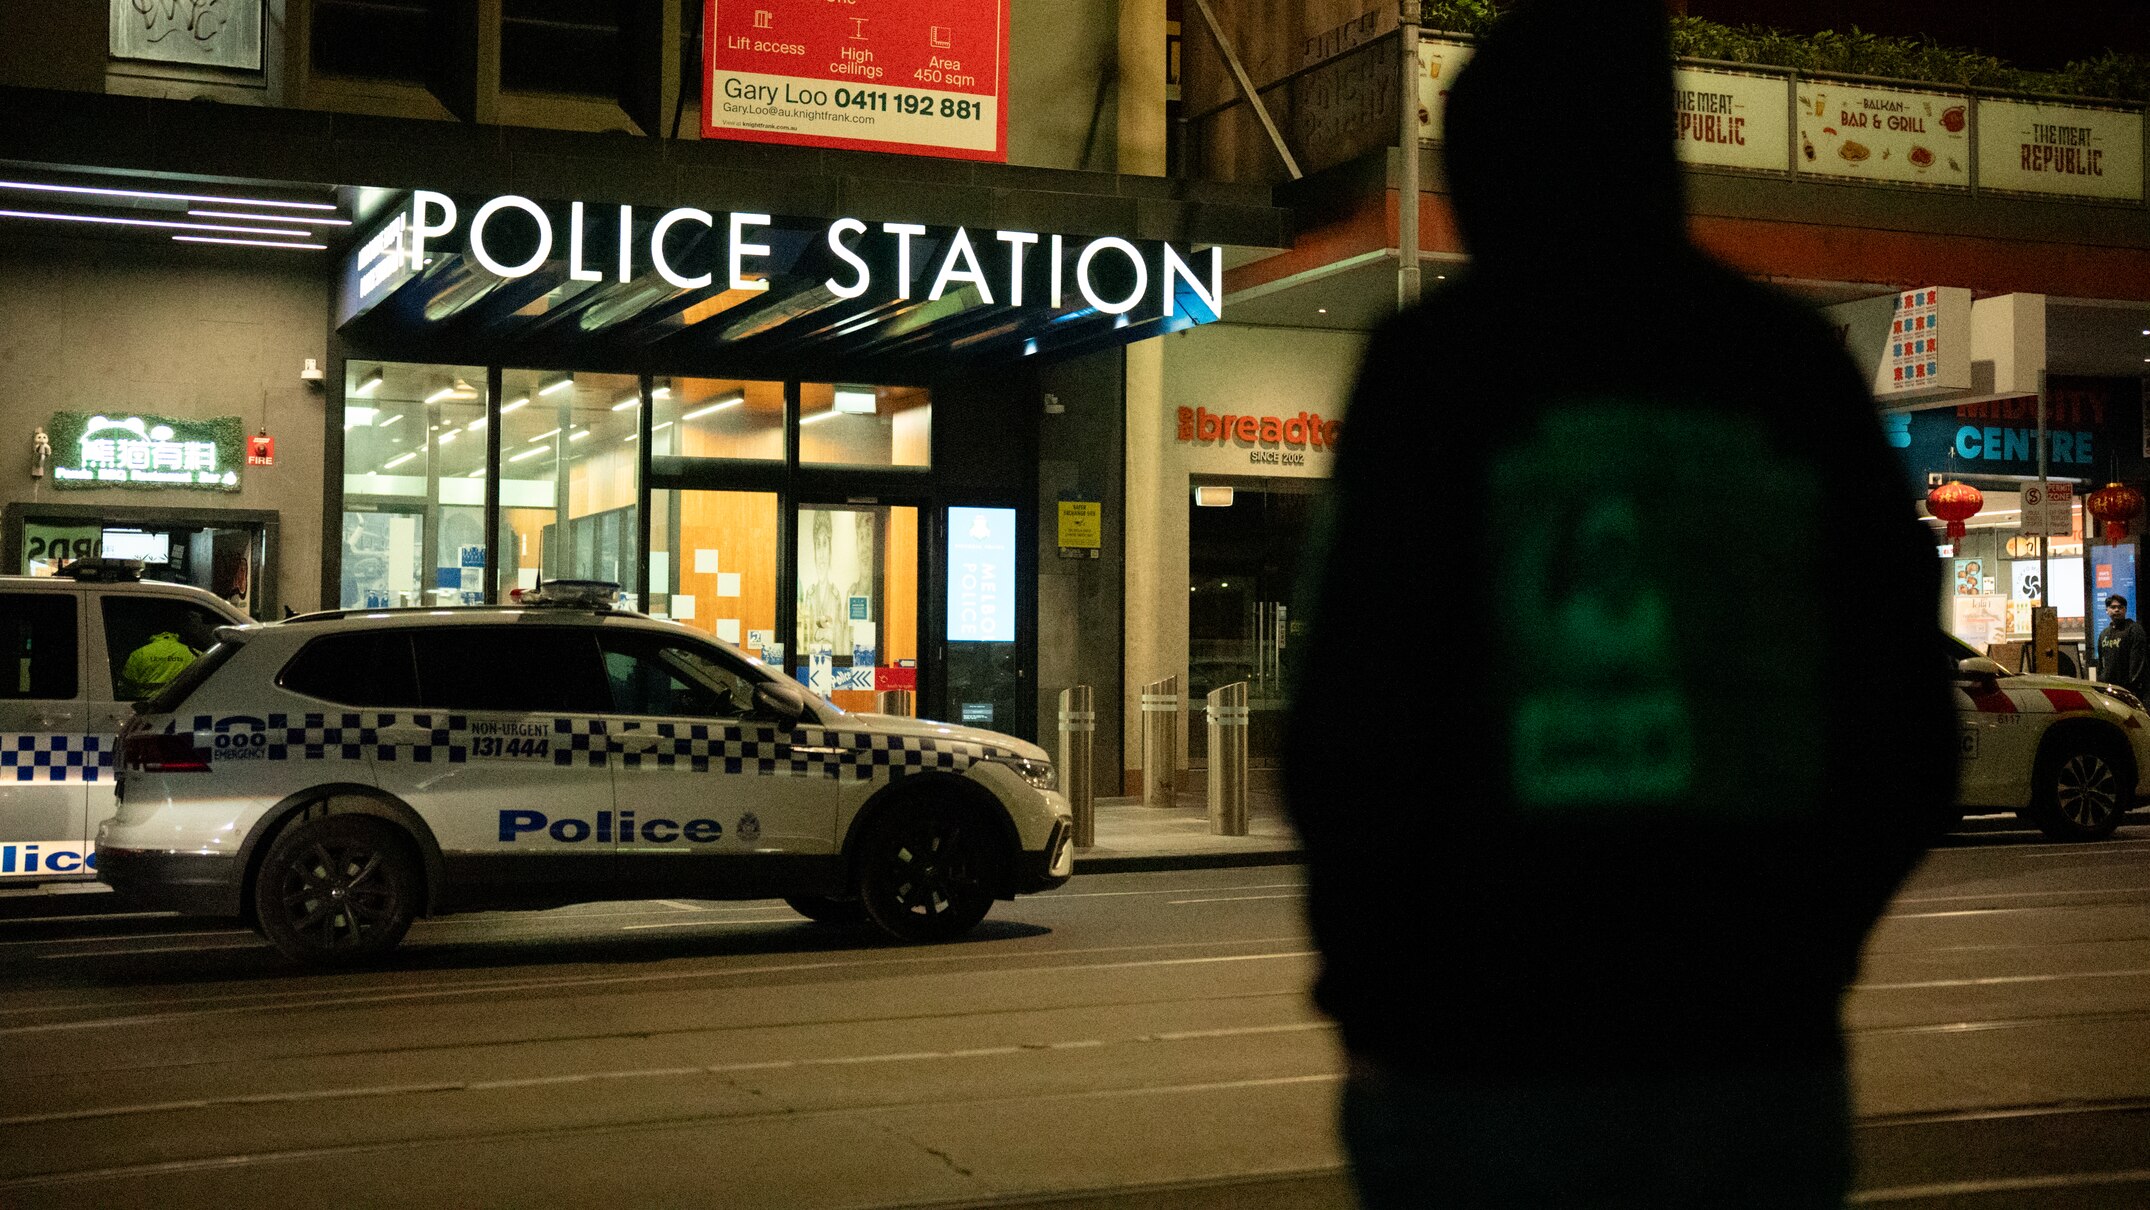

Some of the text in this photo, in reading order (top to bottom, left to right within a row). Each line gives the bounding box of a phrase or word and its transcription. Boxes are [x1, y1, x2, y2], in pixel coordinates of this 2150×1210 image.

[728, 35, 805, 55] Lift access
[841, 47, 873, 63] High
[830, 62, 883, 78] ceilings
[929, 56, 960, 71] Area
[914, 69, 975, 87] 450 sqm
[724, 78, 981, 120] Gary Loo 0411 192 881
[1673, 89, 1734, 114] HE MEAT
[1863, 98, 1904, 112] BALKAN
[723, 102, 875, 124] Gary.Loo@au.knightfrank.com
[1841, 110, 1926, 133] BAR & GRILL
[742, 121, 798, 131] knightfrank.com.au
[1673, 111, 1745, 146] PUBLIC
[2058, 126, 2092, 147] MEAT
[2021, 144, 2103, 176] REPUBLIC
[411, 190, 771, 290] POLICE
[825, 218, 1222, 319] STATION
[1955, 425, 2094, 464] CENTRE
[248, 456, 273, 465] FIRE
[1250, 451, 1305, 466] SINCE 2002
[960, 563, 977, 635] POLICE
[471, 721, 549, 737] NON-URGENT
[215, 733, 266, 748] 000
[471, 736, 549, 757] 131 444
[214, 748, 266, 760] EMERGENCY
[498, 809, 723, 844] Police
[2, 845, 97, 873] lic
